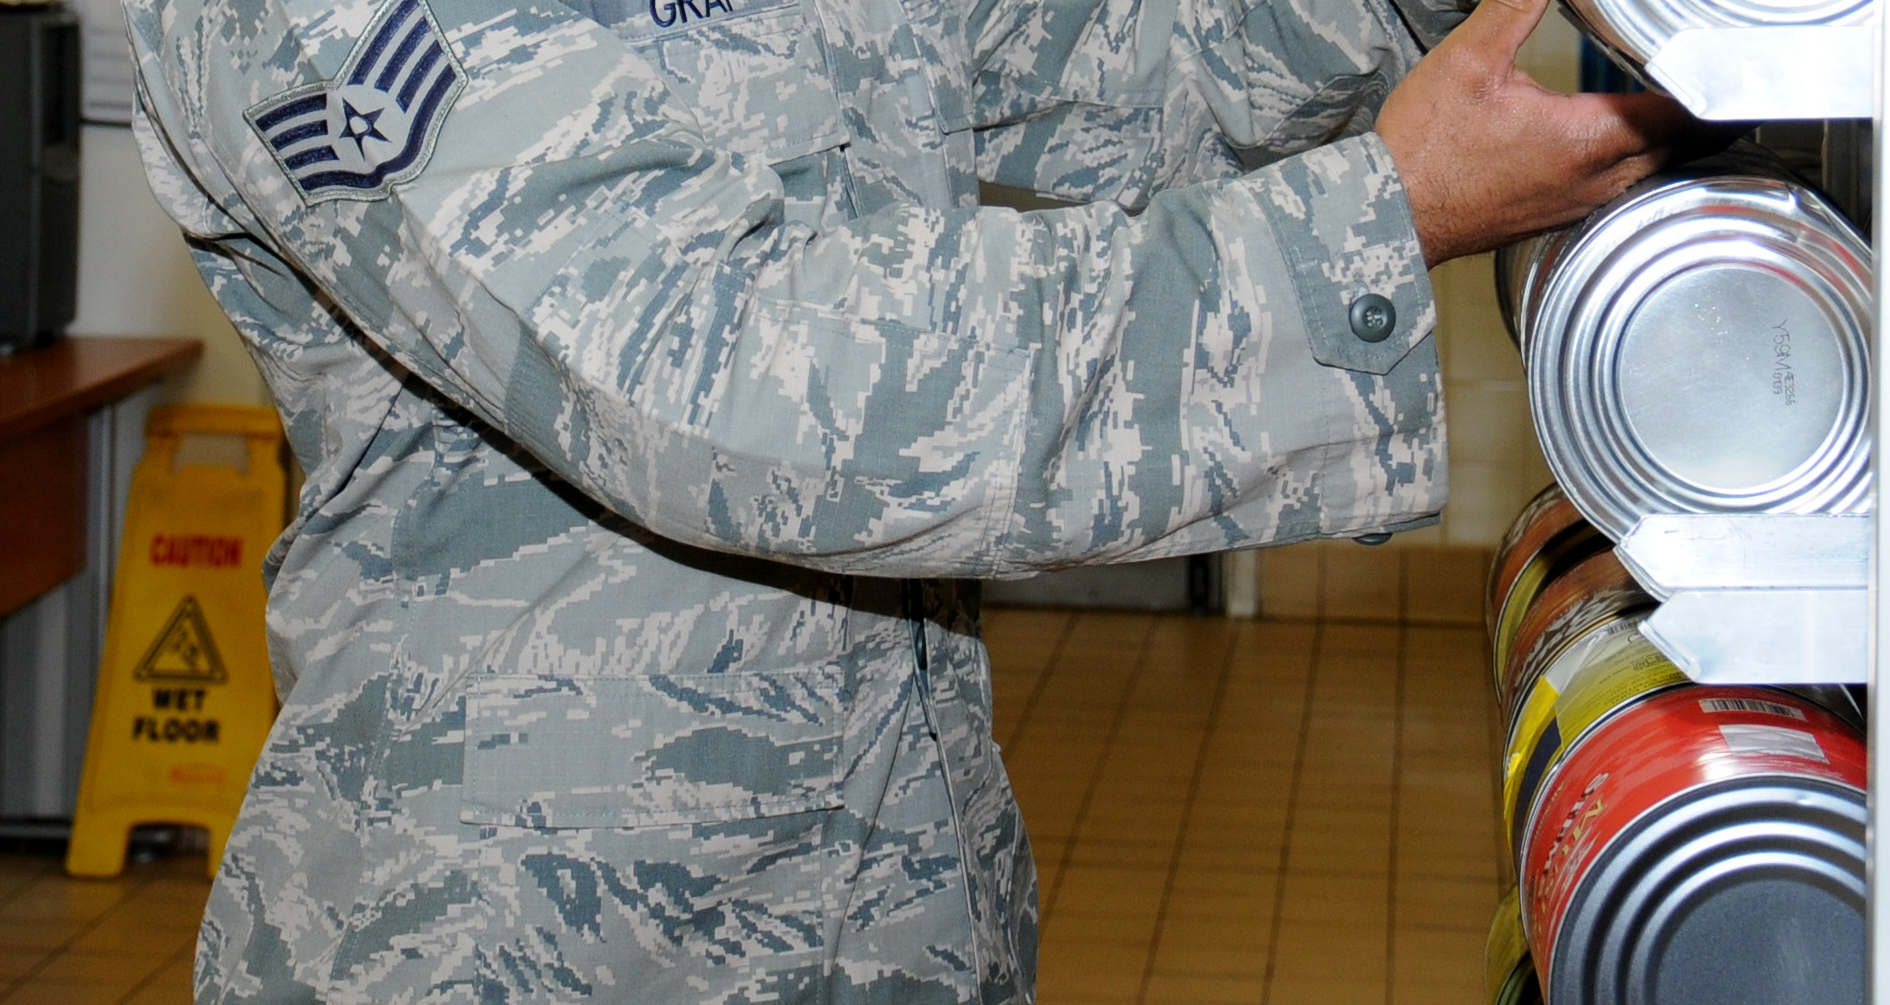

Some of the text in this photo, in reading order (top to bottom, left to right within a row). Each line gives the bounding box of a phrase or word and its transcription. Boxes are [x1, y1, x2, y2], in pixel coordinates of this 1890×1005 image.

[149, 533, 244, 569] CAUTION
[151, 688, 206, 713] WET
[132, 717, 220, 743] FLOOR
